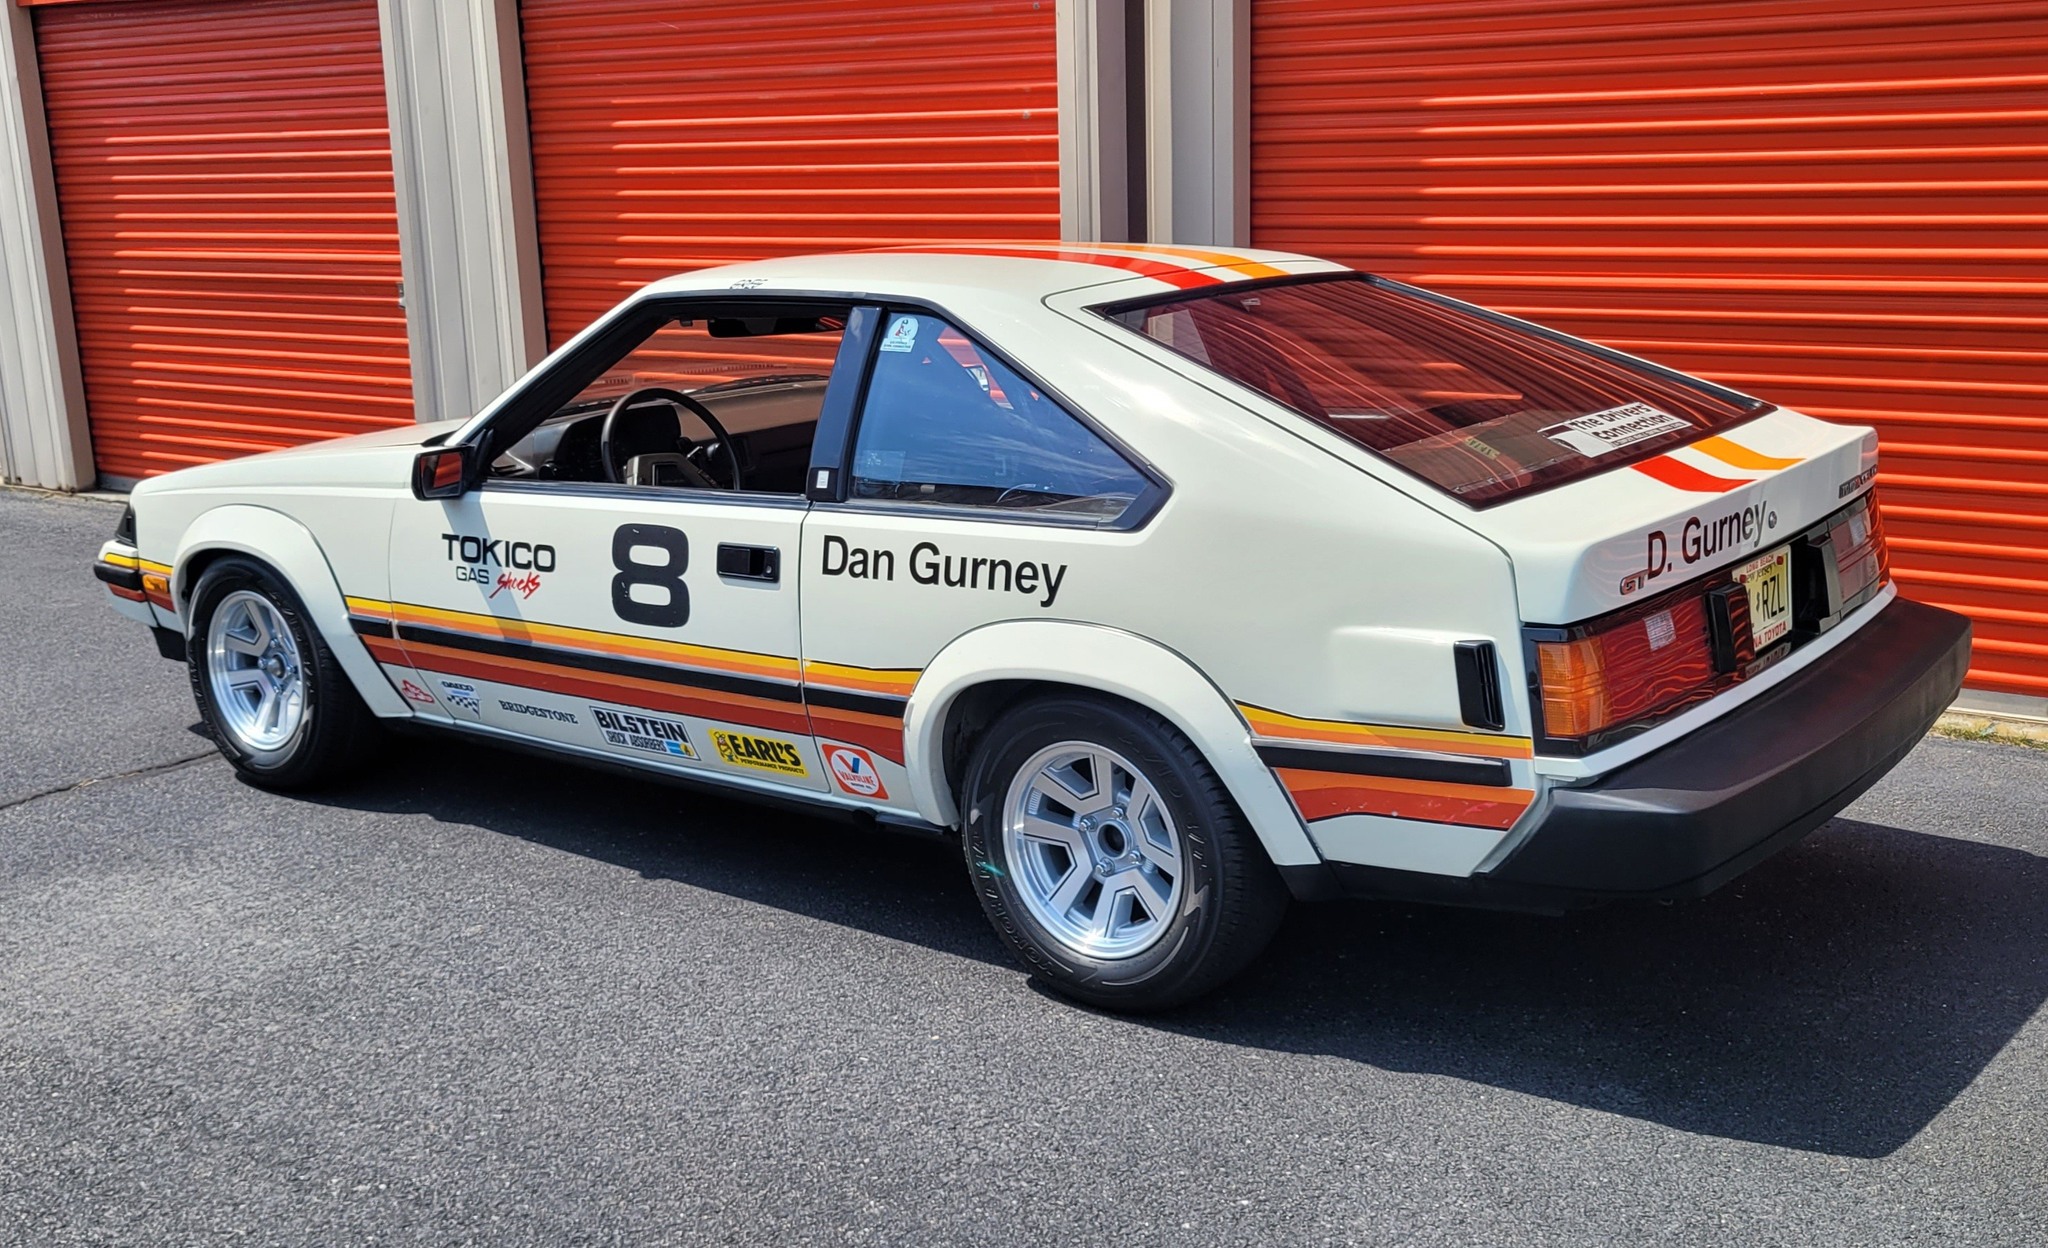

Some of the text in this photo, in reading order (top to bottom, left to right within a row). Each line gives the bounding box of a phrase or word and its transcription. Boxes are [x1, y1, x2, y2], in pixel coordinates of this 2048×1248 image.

[1569, 419, 1603, 431] The
[1591, 414, 1674, 440] Connection
[441, 533, 556, 573] TOKICO
[1647, 500, 1767, 580] D. Gurney
[456, 566, 489, 585] GAS
[611, 523, 691, 628] 8
[822, 534, 1068, 607] Dan Gurney
[1761, 573, 1785, 622] RZL
[1764, 621, 1787, 641] TOYOTA
[498, 699, 579, 724] BRIDGESTONE
[593, 709, 689, 743] BILSTEIN
[727, 734, 802, 767] EARL'S
